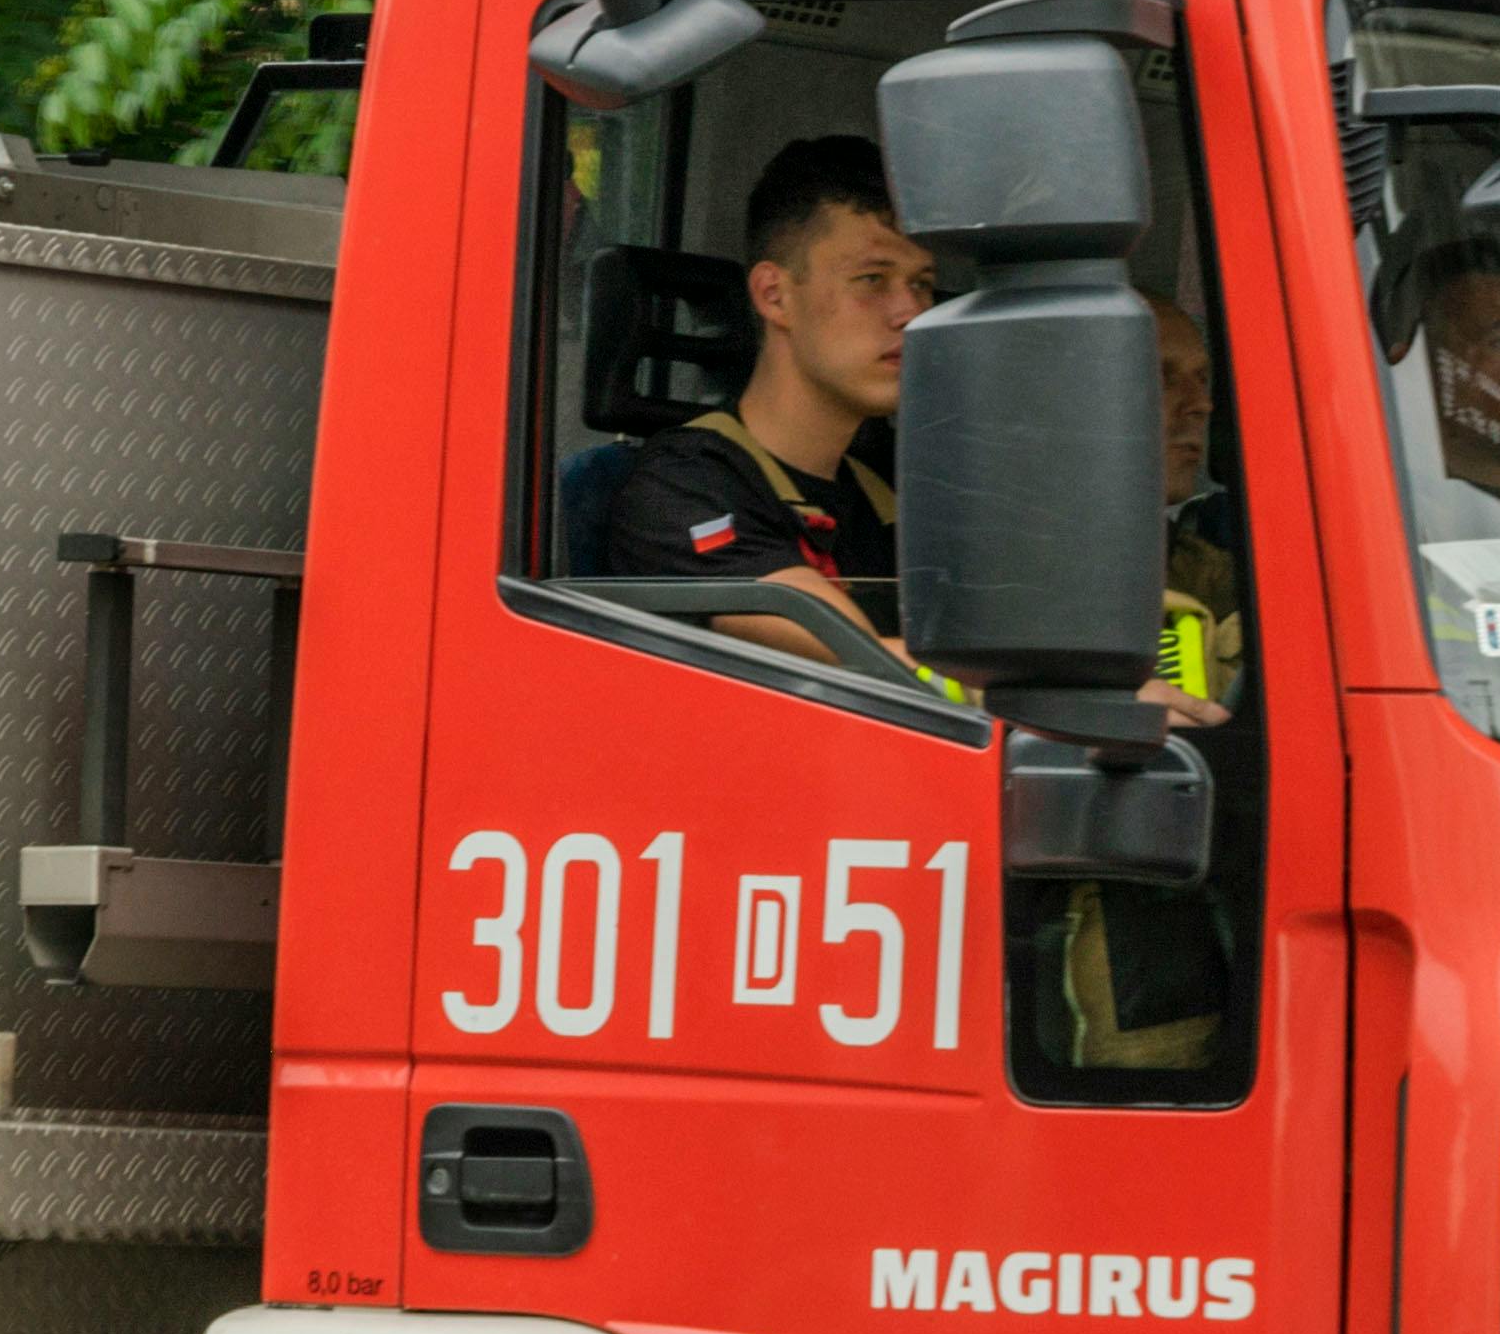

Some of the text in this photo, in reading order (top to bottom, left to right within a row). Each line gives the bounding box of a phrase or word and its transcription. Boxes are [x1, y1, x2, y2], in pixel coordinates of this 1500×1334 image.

[442, 830, 685, 1039] 301
[819, 838, 969, 1050] 51
[307, 1270, 384, 1296] 8,0 bar
[871, 1248, 1256, 1321] MAGIRUS
